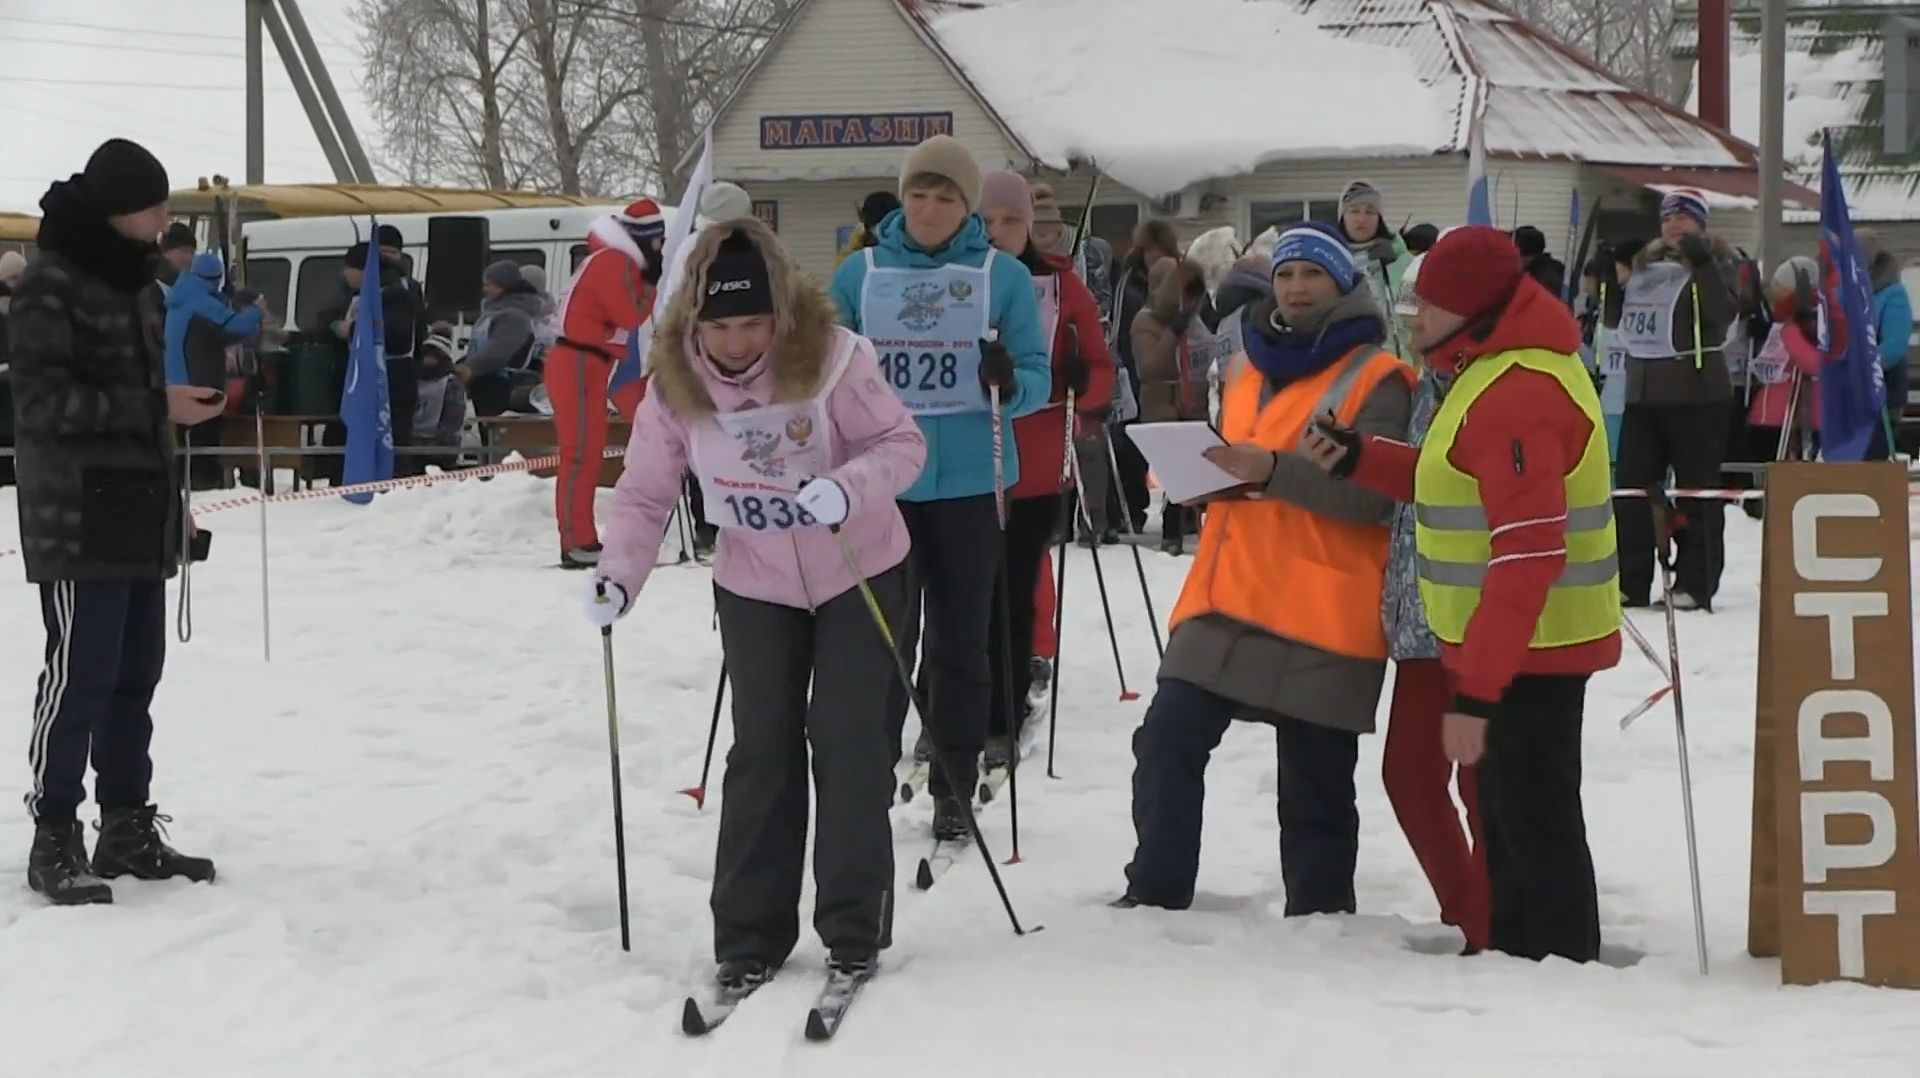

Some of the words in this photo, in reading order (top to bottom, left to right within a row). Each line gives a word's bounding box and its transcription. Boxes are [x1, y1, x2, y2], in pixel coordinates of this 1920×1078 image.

[764, 115, 949, 146] МАГАЗИН
[880, 352, 957, 391] 1828
[1792, 493, 1896, 979] СТАРТ
